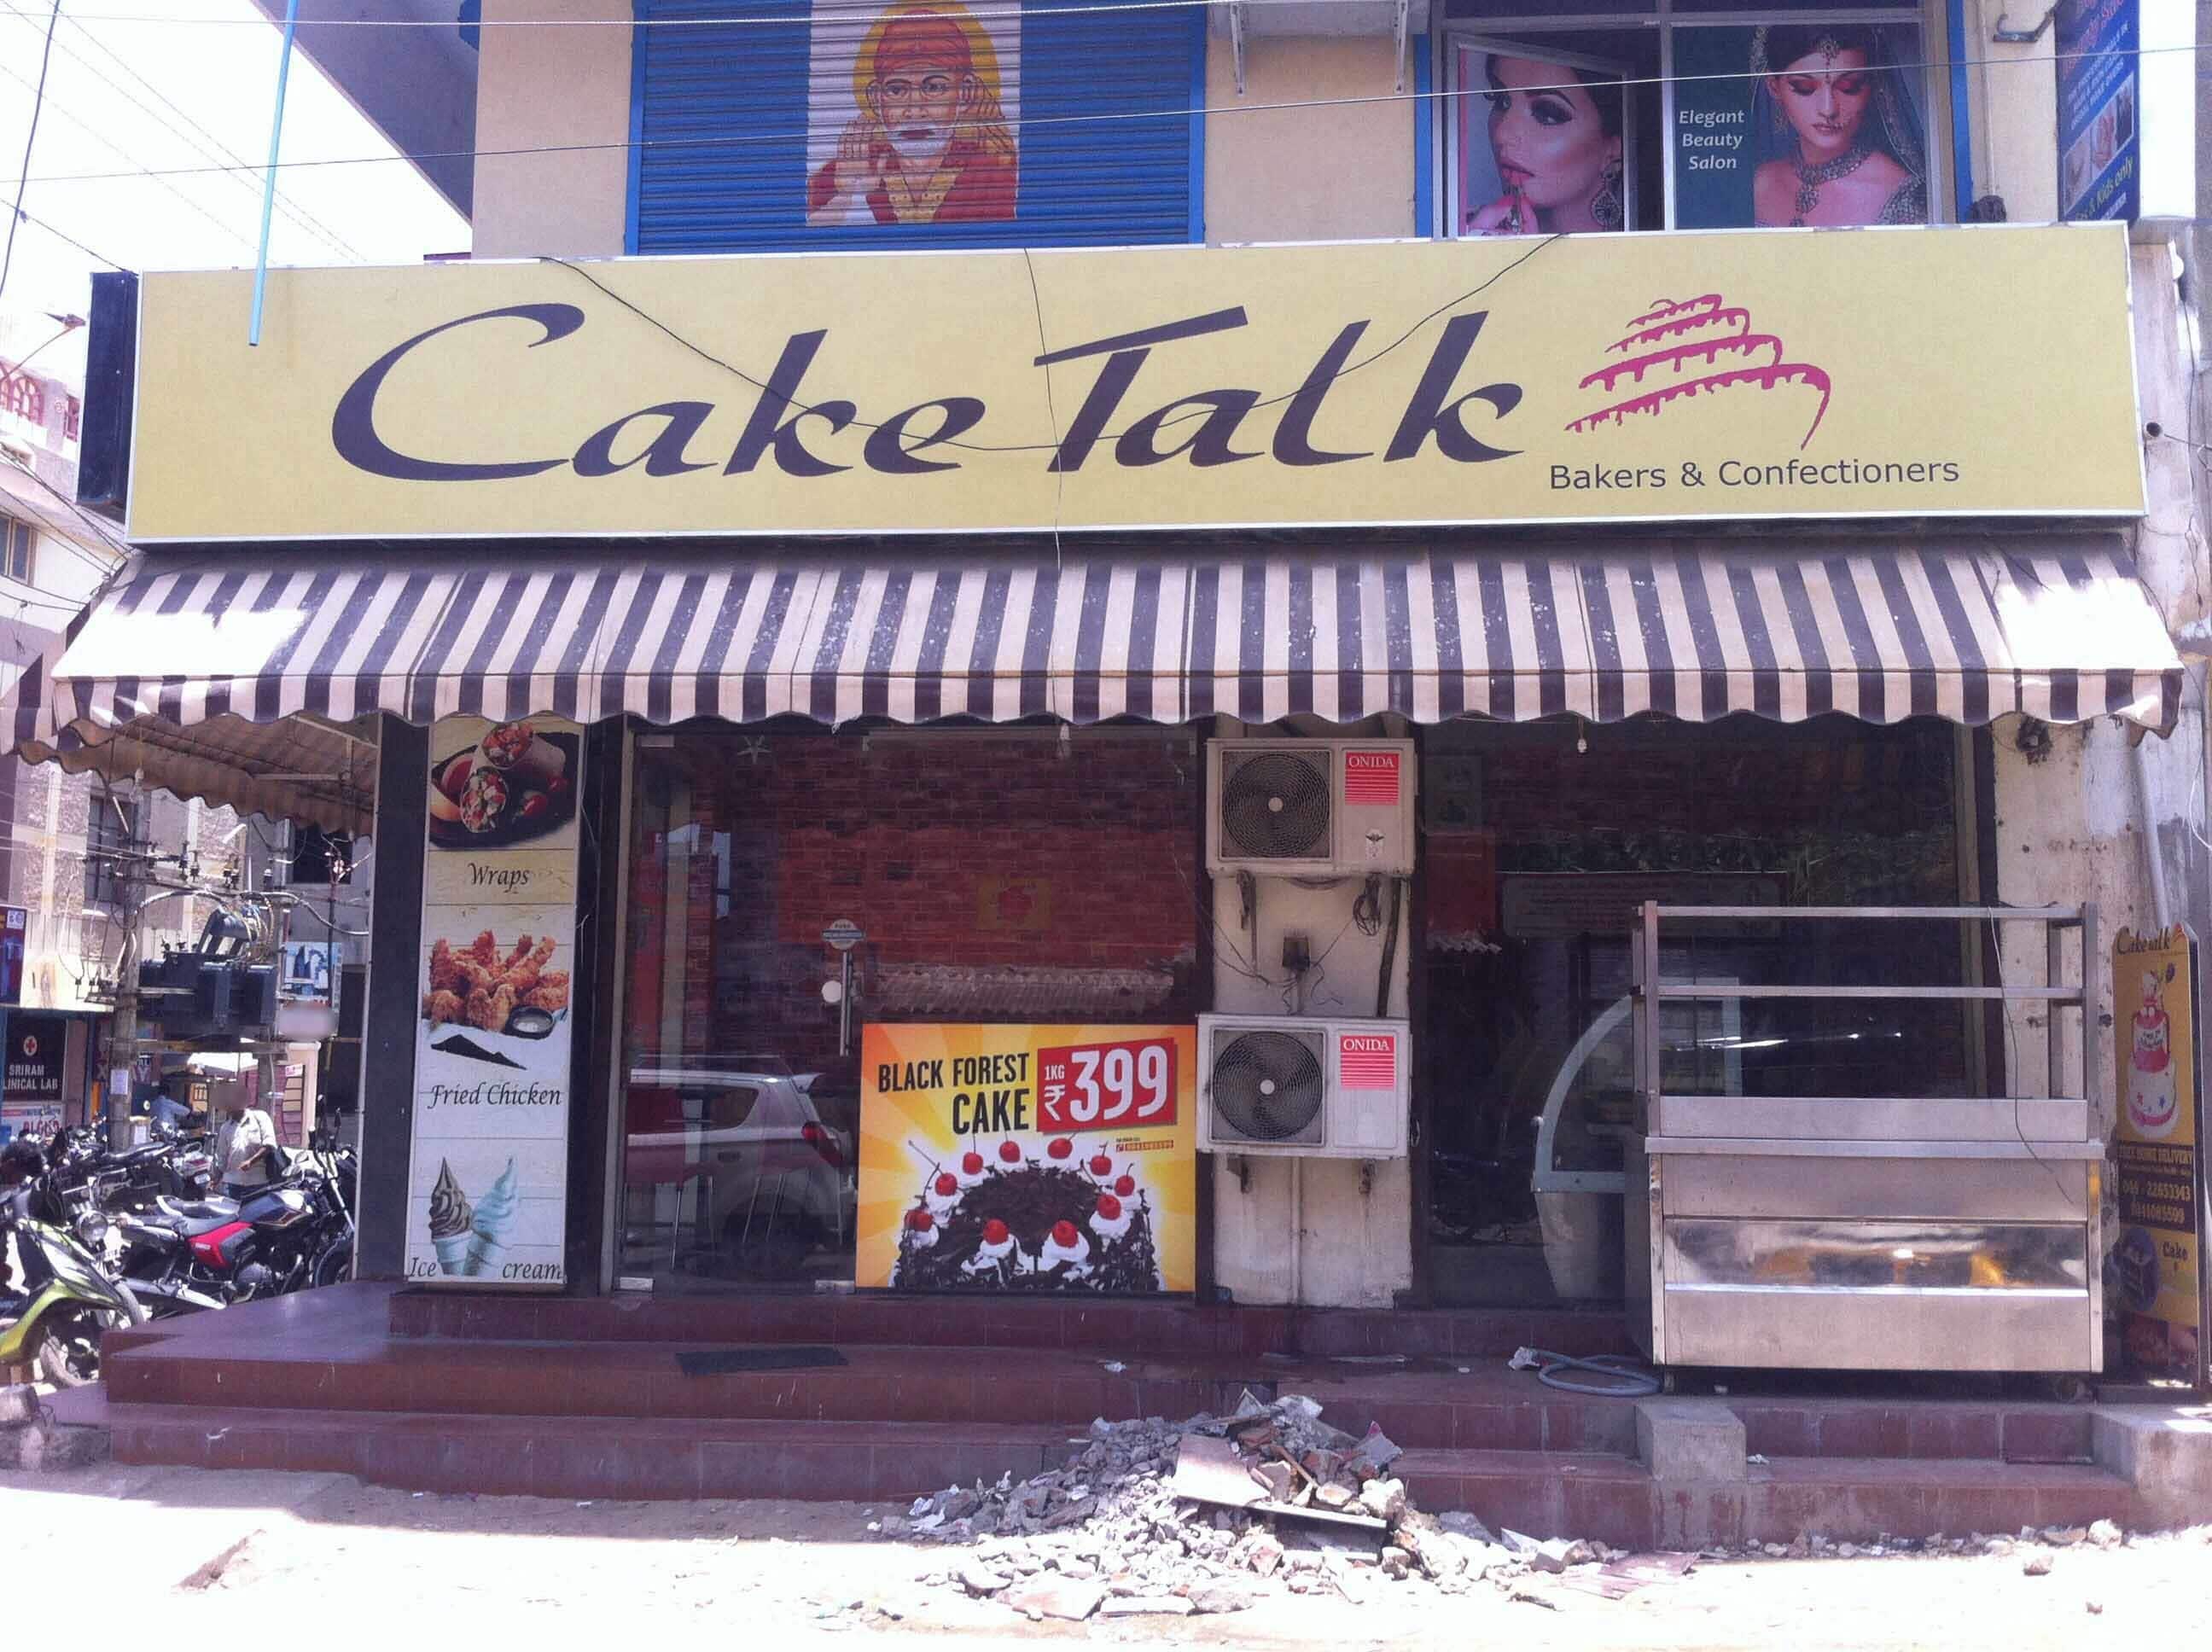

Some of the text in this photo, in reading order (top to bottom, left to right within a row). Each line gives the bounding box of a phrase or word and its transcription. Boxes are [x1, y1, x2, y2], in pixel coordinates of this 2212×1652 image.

[1679, 109, 1745, 128] Elegant
[1682, 133, 1743, 150] Beauty
[1688, 154, 1737, 170] Salon
[332, 303, 1525, 481] Cake Talk
[1550, 458, 1960, 490] Bakers & Confectioners
[1348, 755, 1395, 769] ONIDA
[467, 862, 531, 893] Wraps
[1342, 1038, 1390, 1052] ONIDA
[9, 1064, 45, 1076] SRIRAM
[878, 1053, 1030, 1093] BLACK FOREST
[1044, 1064, 1066, 1080] 1KG
[2, 1078, 58, 1091] LINICAL LAB
[427, 1081, 562, 1109] Fried Chicken
[952, 1088, 1031, 1135] CAKE
[409, 1258, 562, 1278] Ice cream
